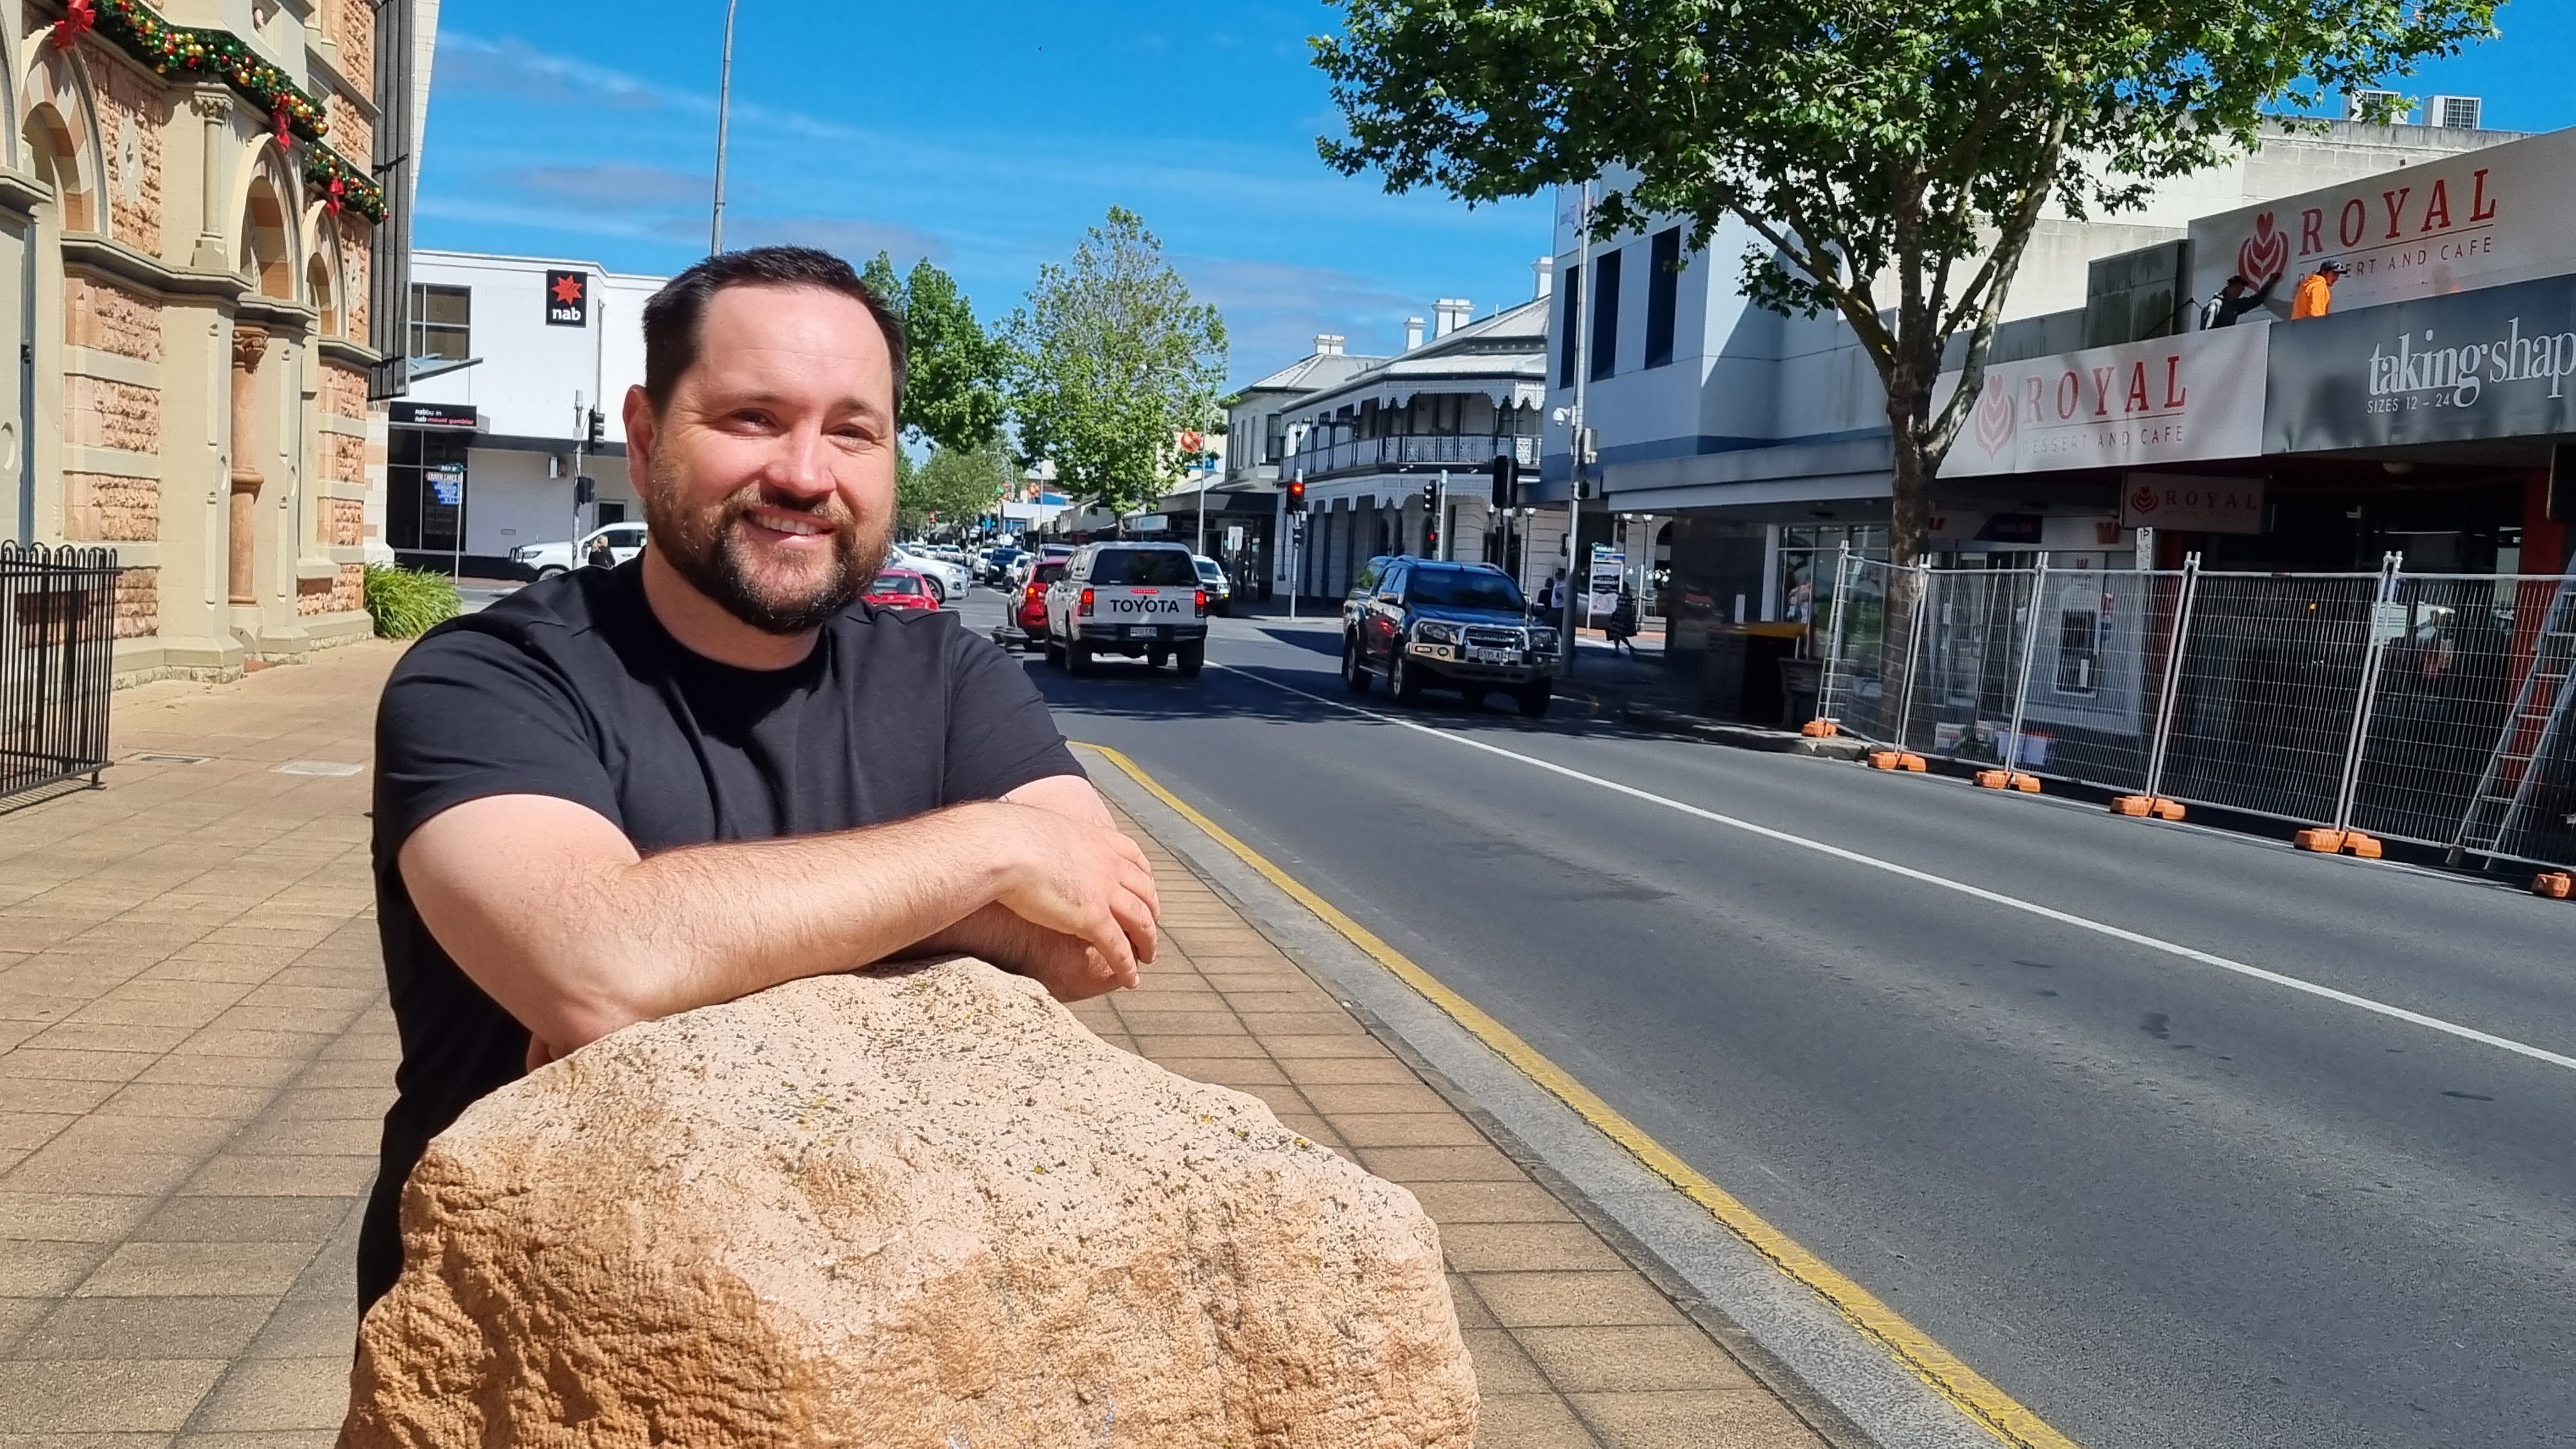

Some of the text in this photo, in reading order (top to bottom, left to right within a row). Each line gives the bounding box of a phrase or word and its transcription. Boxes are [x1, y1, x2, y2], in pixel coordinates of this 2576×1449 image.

[2299, 169, 2496, 256] ROYAL
[2388, 250, 2426, 271] AND
[2441, 236, 2492, 261] CAFE
[552, 307, 581, 321] nab
[2368, 328, 2488, 408] taking
[2023, 355, 2186, 424] ROYAL
[2366, 397, 2398, 414] SIZES
[2405, 396, 2418, 410] 12
[2435, 393, 2450, 408] 24
[2022, 425, 2183, 455] DESSERT AND CAFE
[2165, 489, 2257, 510] ROYAL
[1110, 599, 1180, 613] TOYOTA
